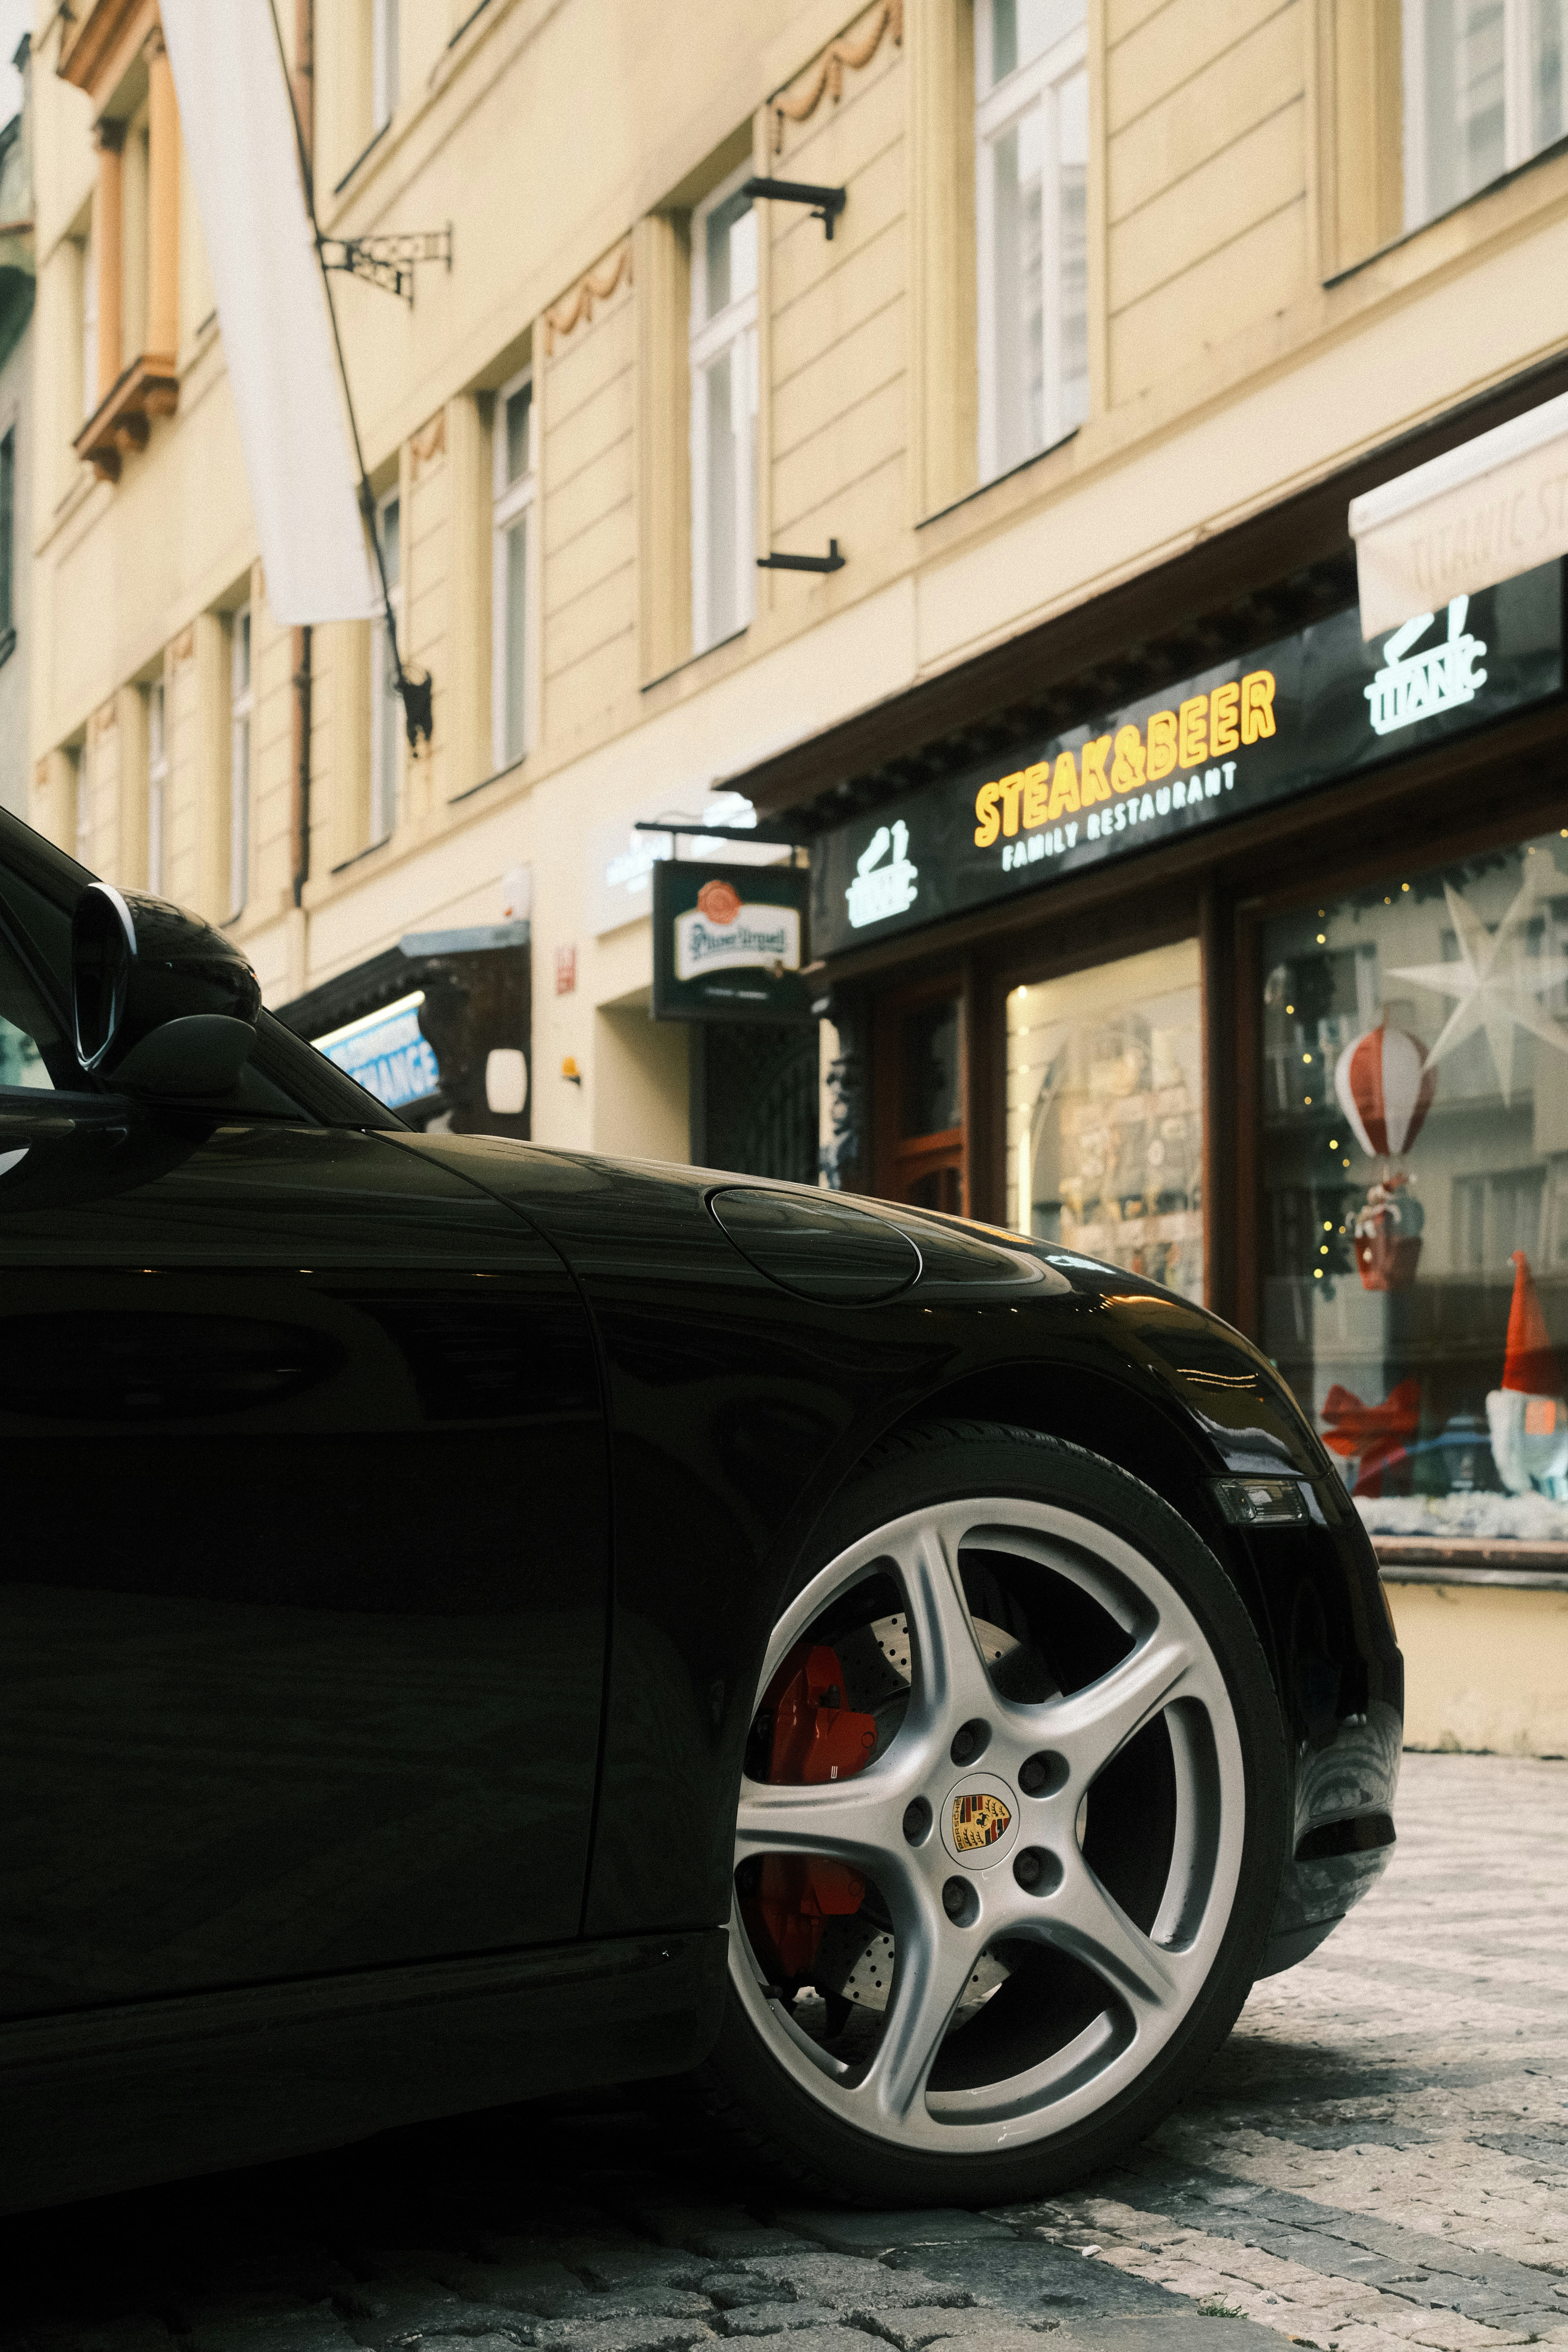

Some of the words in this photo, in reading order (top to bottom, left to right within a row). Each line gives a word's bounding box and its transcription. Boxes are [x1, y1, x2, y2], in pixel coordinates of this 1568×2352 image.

[1364, 640, 1487, 728] TITANIC
[974, 670, 1277, 848] STEAK&BEER
[1002, 821, 1079, 872] FAMILY
[1087, 761, 1237, 841] RESTAURANT
[954, 1799, 964, 1849] PORSCHE
